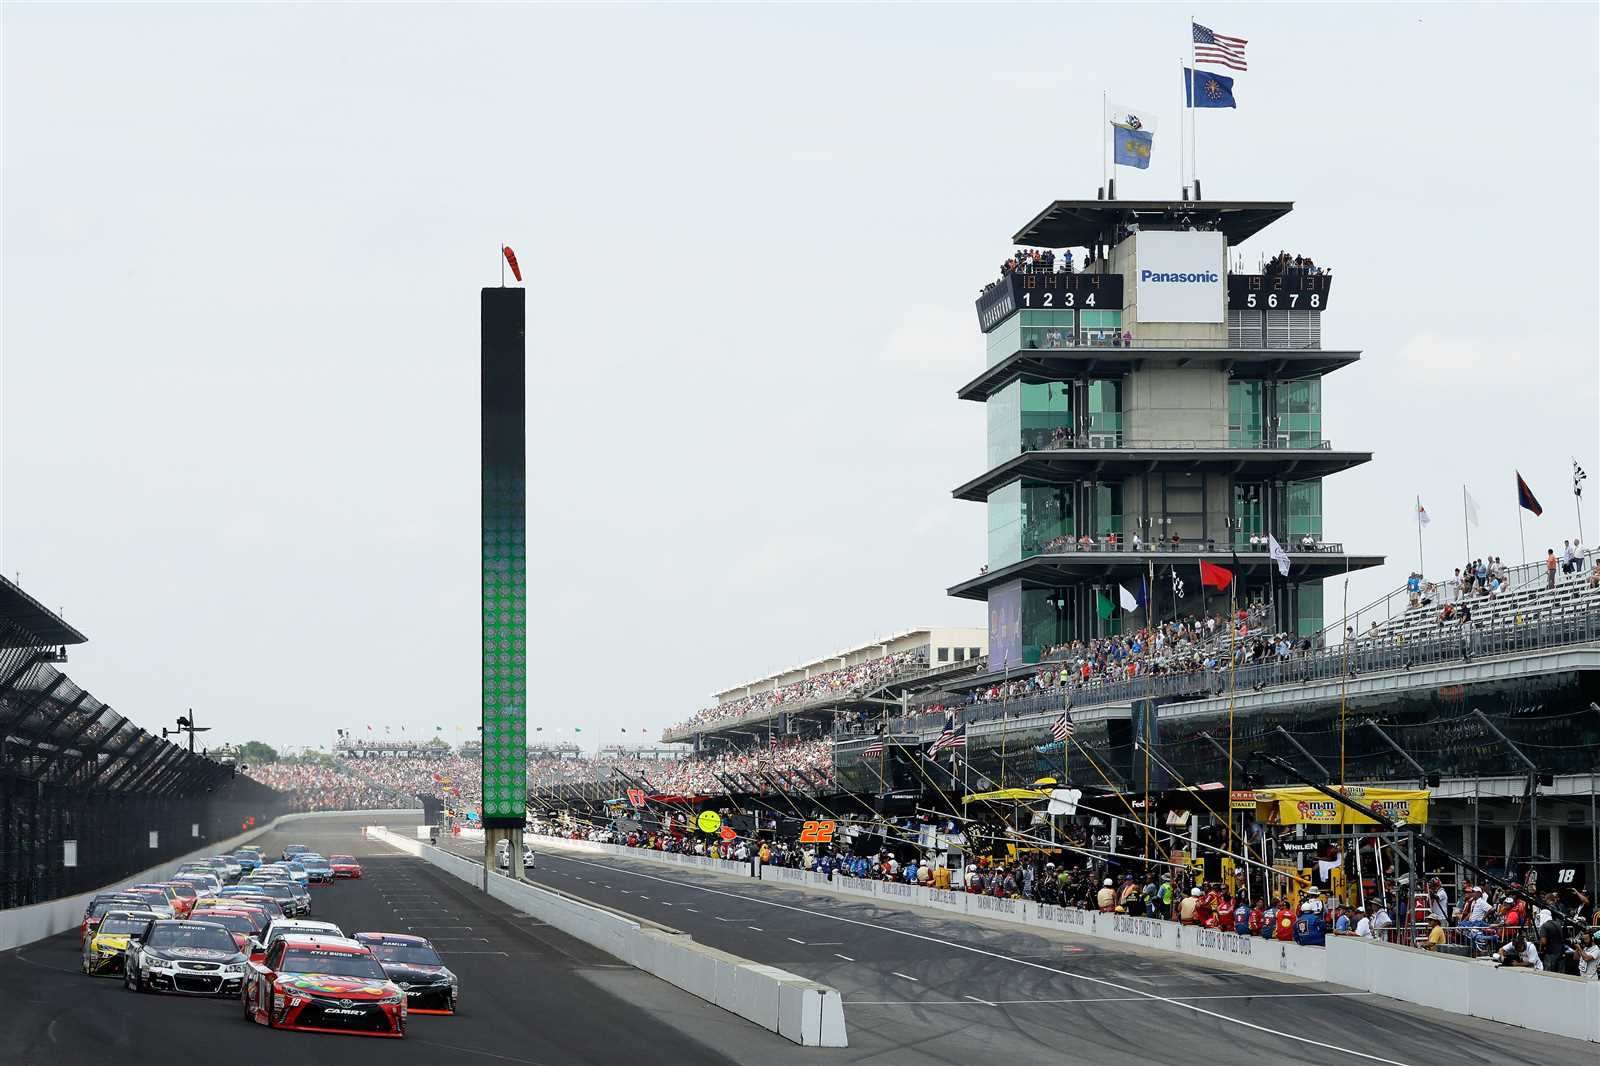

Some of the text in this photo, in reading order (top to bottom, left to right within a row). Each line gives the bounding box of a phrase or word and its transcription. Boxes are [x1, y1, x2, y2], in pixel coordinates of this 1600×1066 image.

[1141, 269, 1218, 283] Panasonic
[1023, 293, 1096, 307] 1 2 3 4
[1247, 293, 1320, 308] 5 6 7 8
[800, 820, 835, 842] 22
[1558, 869, 1576, 883] 18
[290, 998, 301, 1007] 18
[324, 1008, 367, 1016] CAMRY
